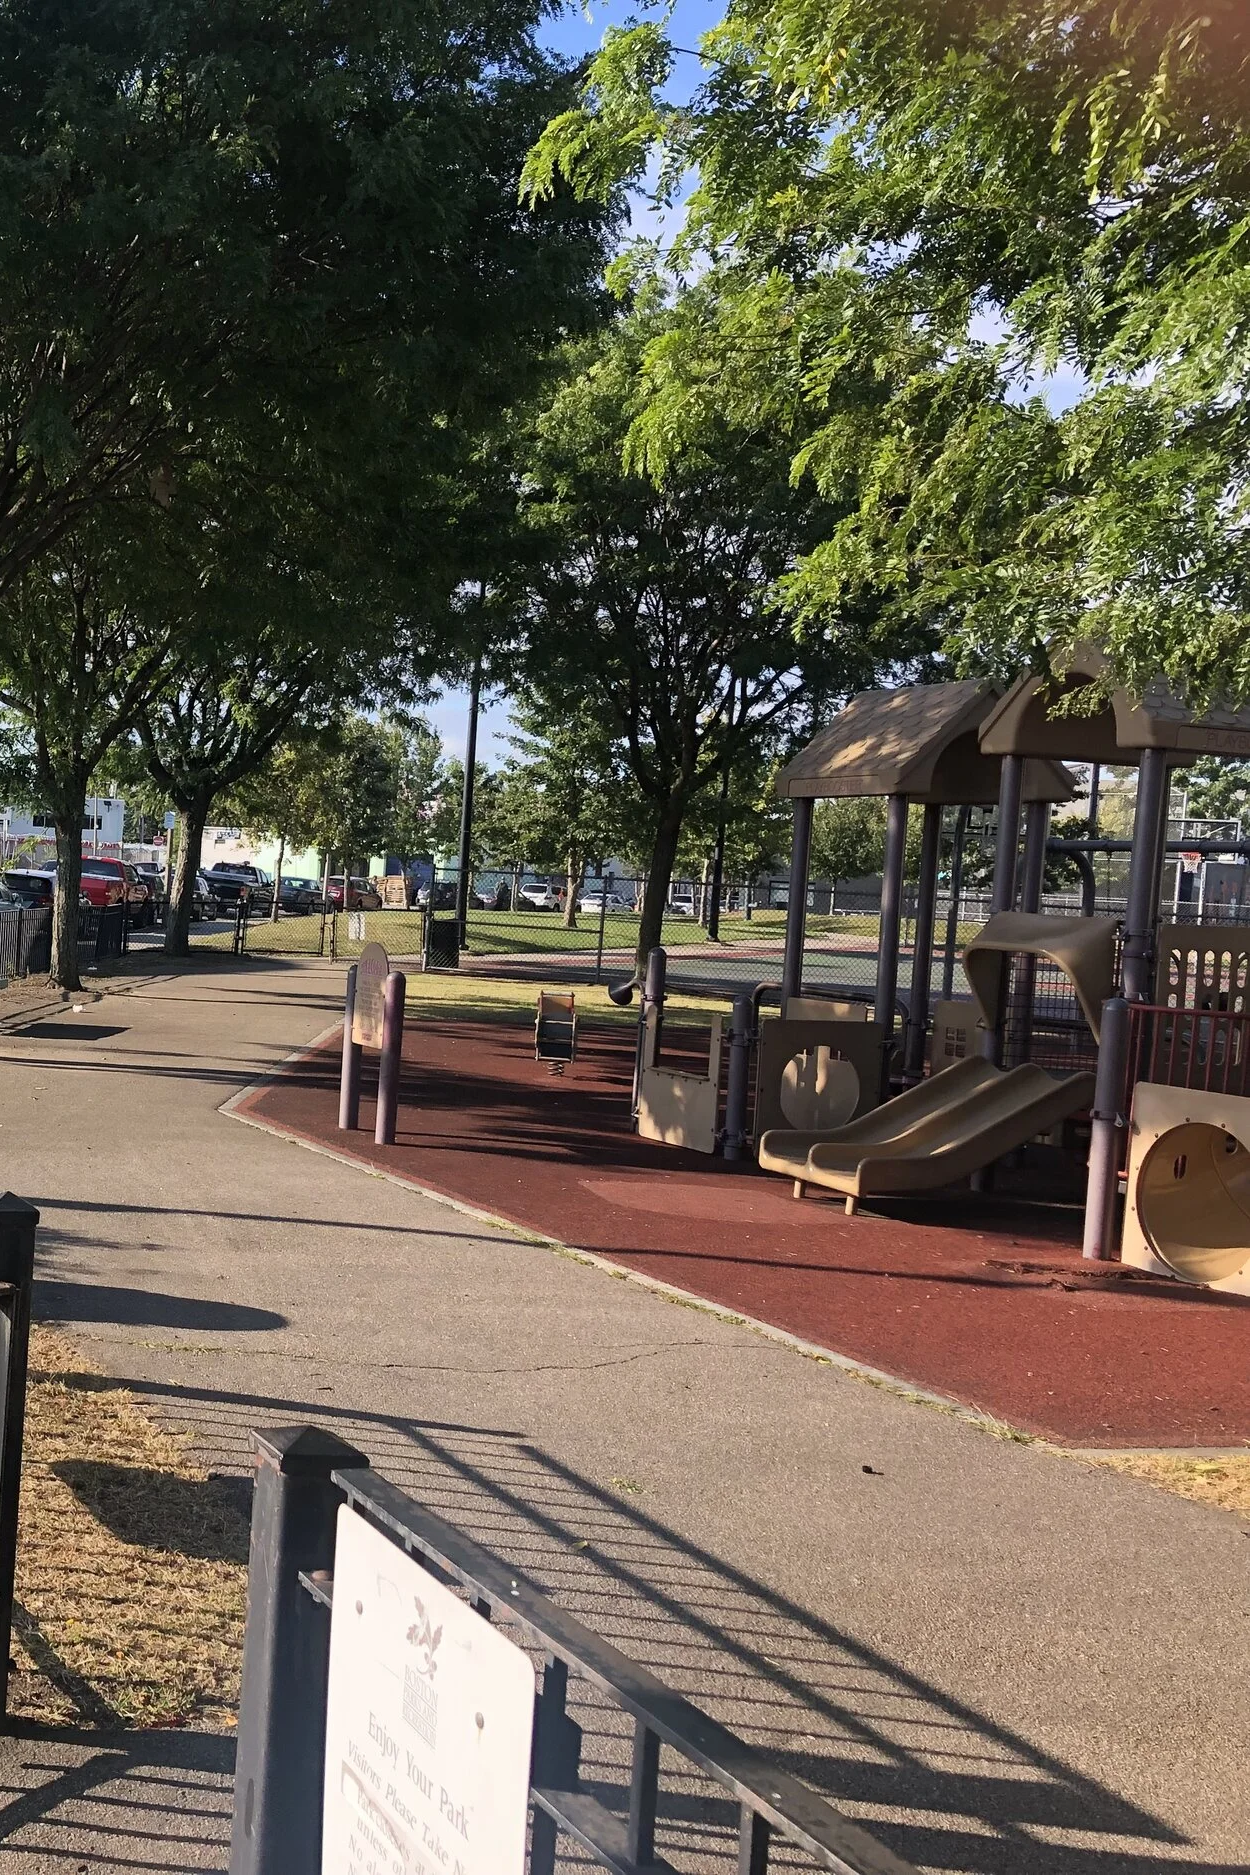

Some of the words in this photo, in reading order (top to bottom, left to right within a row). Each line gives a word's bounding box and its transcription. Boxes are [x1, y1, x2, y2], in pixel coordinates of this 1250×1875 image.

[348, 1739, 381, 1790] Visitors
[385, 1782, 417, 1830] Please
[422, 1822, 449, 1866] Take
[368, 1711, 399, 1769] Enjoy
[405, 1750, 434, 1800] Your
[439, 1786, 470, 1841] Park
[348, 1834, 363, 1861] No
[357, 1816, 387, 1861] unless
